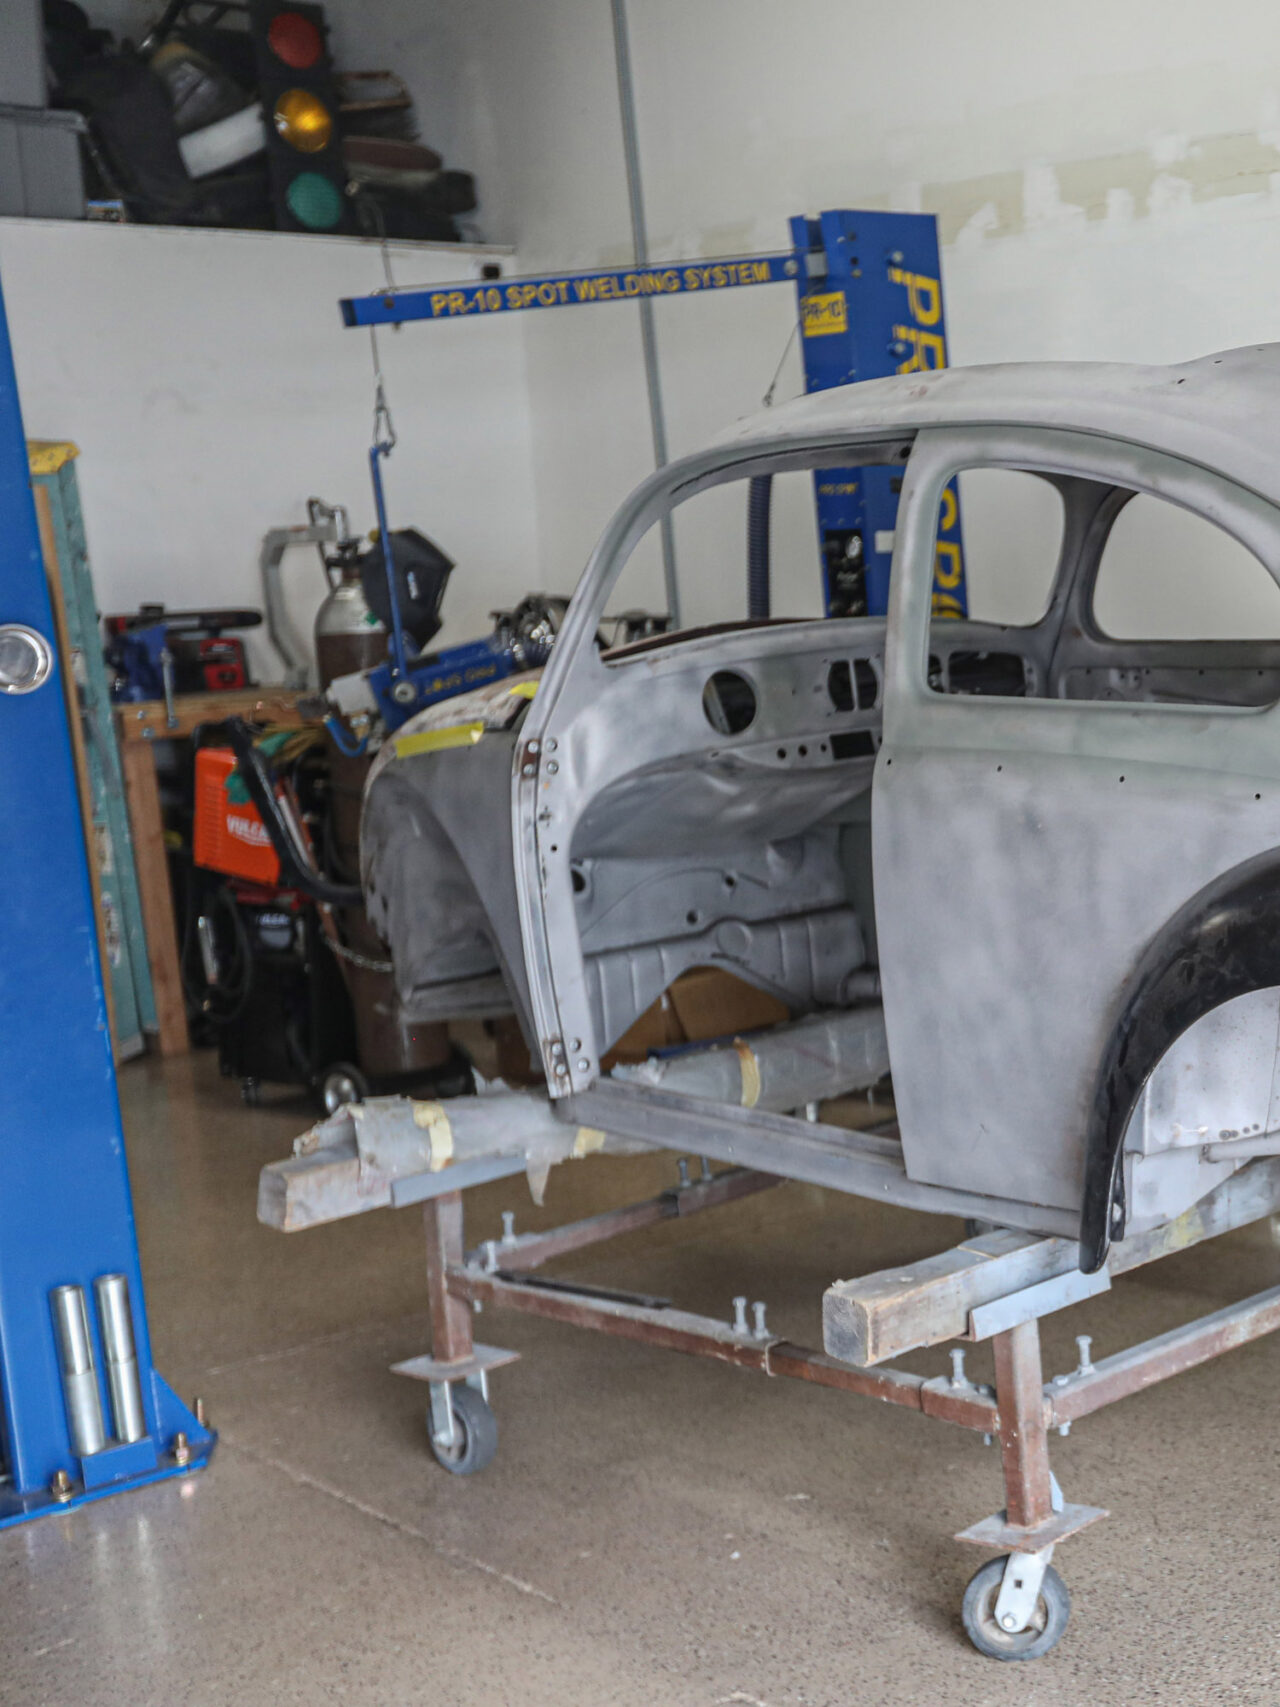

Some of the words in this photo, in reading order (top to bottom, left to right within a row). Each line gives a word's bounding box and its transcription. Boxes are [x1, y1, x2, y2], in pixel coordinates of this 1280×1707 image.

[430, 288, 502, 316] PR-10
[505, 281, 569, 309] SPOT
[574, 270, 680, 301] WELDING
[683, 261, 771, 290] SYSTEM
[226, 813, 270, 839] VULCA
